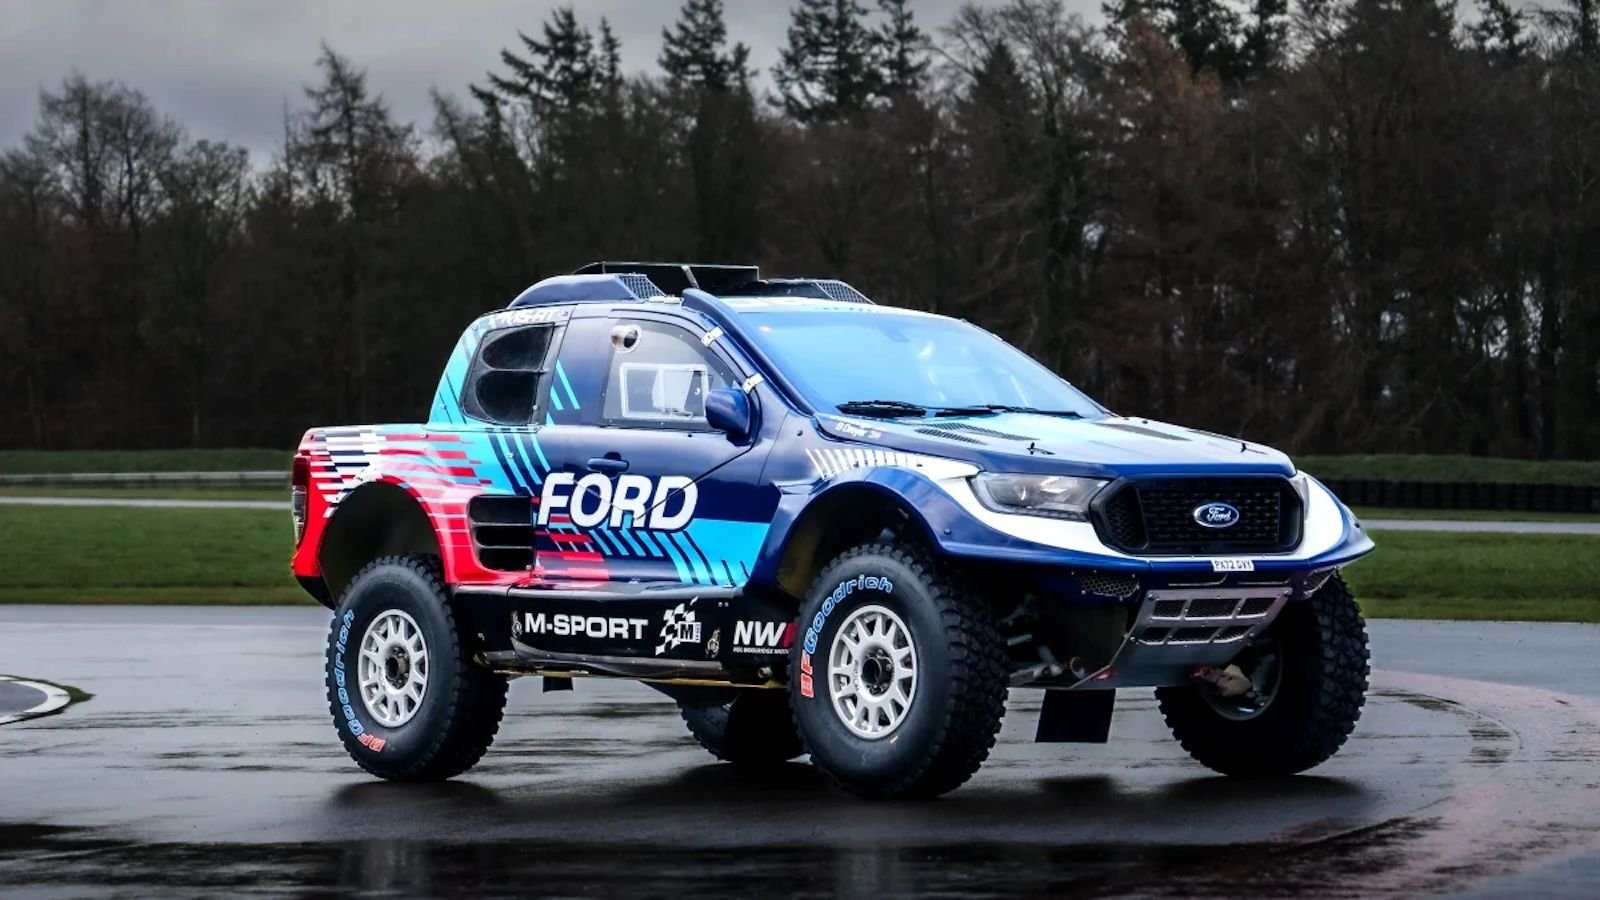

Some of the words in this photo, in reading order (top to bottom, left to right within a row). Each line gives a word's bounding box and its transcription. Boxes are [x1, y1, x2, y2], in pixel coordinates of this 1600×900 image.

[537, 472, 698, 530] FORD
[1206, 507, 1232, 522] Ford
[524, 612, 649, 640] M-SPORT
[680, 624, 693, 641] M
[800, 574, 893, 698] BFGoodrich
